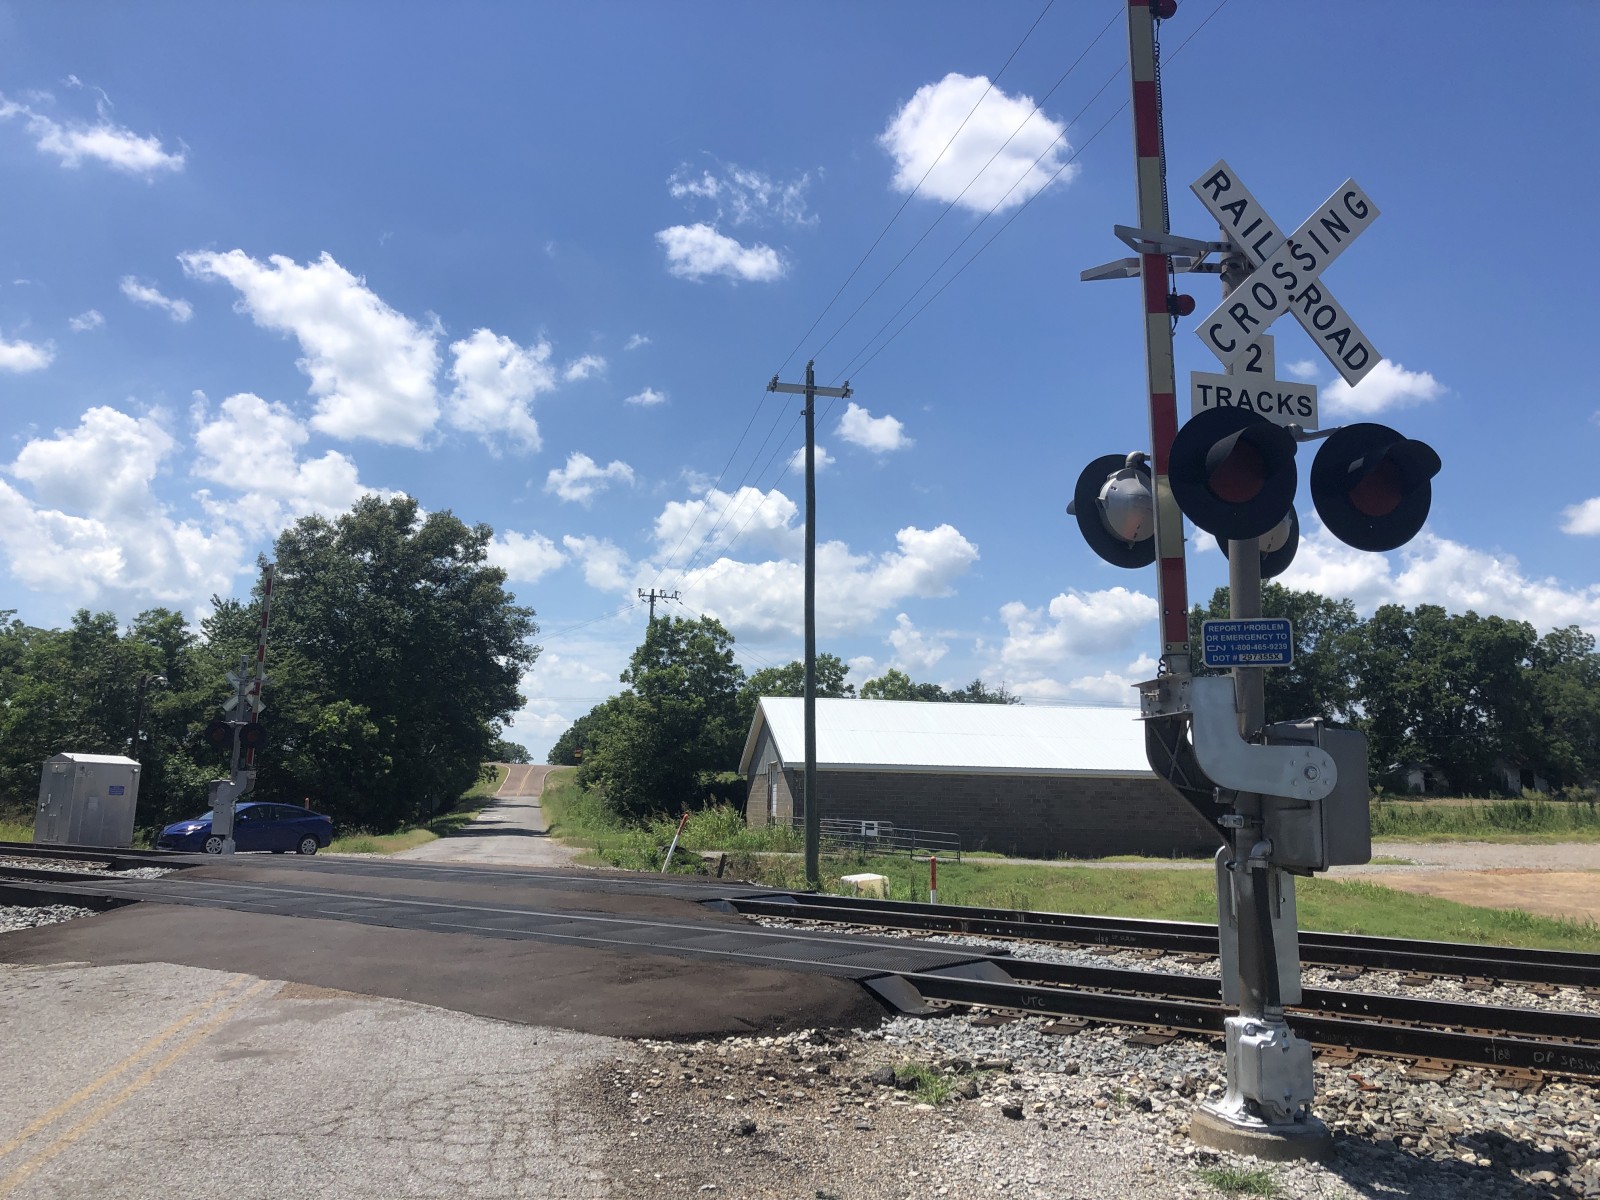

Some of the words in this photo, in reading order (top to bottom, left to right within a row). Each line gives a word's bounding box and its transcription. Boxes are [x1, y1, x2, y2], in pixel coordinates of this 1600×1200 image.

[1203, 169, 1274, 262] RAIL
[1295, 283, 1369, 371] ROAD
[1209, 190, 1369, 353] CROSSING
[1245, 343, 1263, 373] 2
[1197, 384, 1313, 417] TRACKS
[1220, 633, 1273, 642] EMERGENCY
[1243, 623, 1284, 631] PROBLEM
[1231, 643, 1287, 651] 1-800-465-9239
[1021, 995, 1046, 1008] UTC
